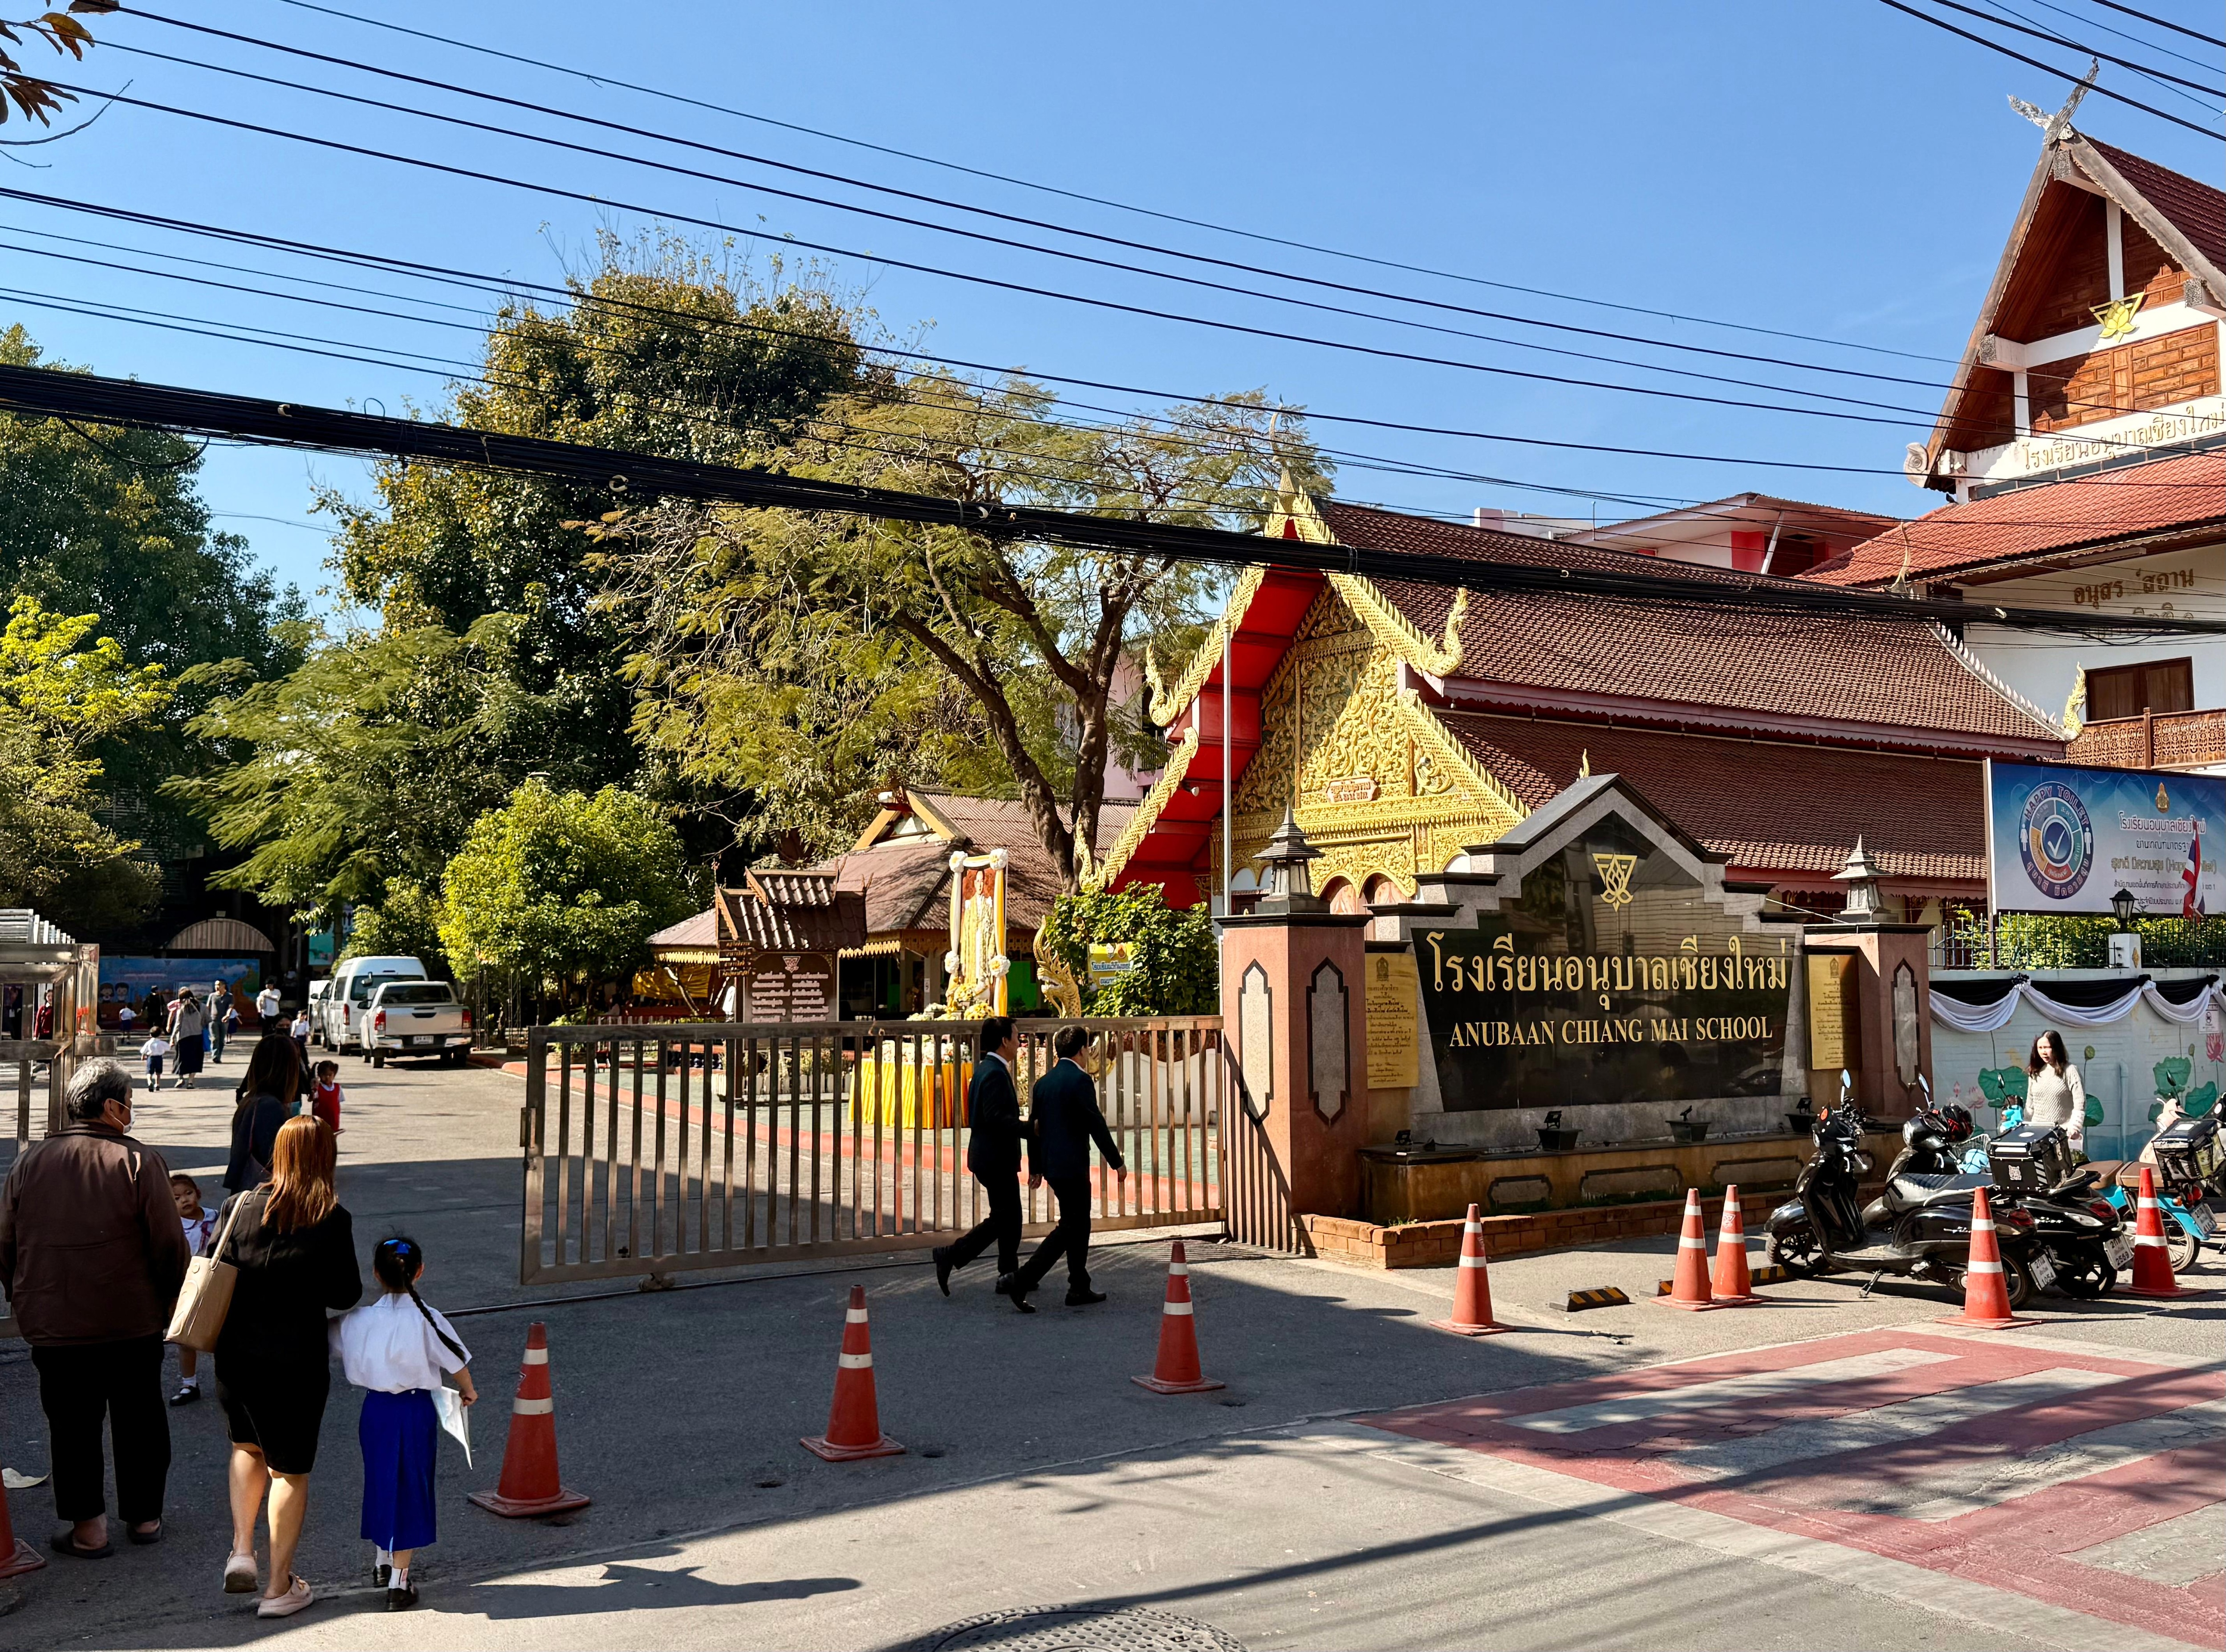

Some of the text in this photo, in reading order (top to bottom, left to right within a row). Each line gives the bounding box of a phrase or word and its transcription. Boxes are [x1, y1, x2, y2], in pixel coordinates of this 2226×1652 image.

[2022, 402, 2224, 469] โรงเรียนอนุบาลเชียงใหม่
[2024, 786, 2052, 821] HAPPY
[2057, 785, 2089, 825] TOILET
[1426, 932, 1787, 1011] โรงเรียนอนุบาลเชียงใหม่
[1450, 1017, 1773, 1047] ANUBAAN CHIANG MAI SCHOOL
